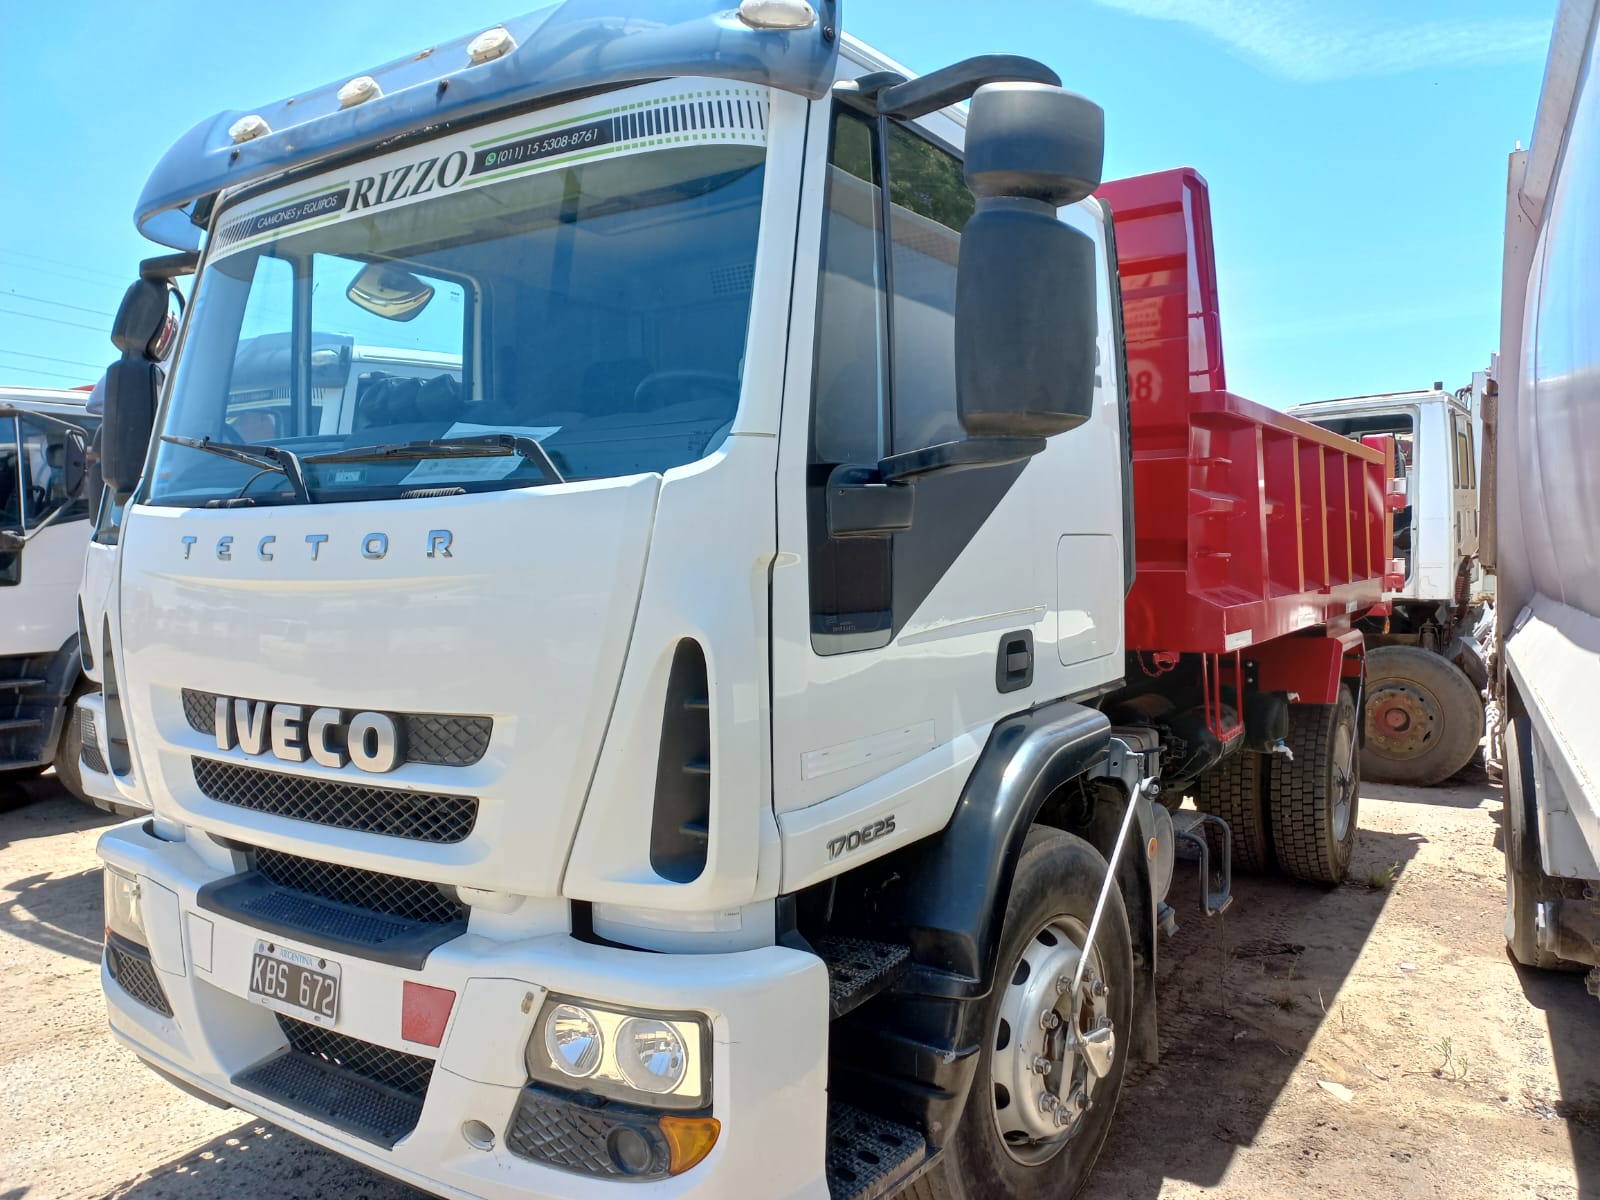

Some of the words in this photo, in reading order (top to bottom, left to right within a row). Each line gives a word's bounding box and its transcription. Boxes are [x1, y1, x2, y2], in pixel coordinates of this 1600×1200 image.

[497, 146, 524, 165] (011)
[527, 143, 540, 156] 15
[541, 128, 598, 152] 5308-8761
[347, 150, 468, 213] RIZZO
[257, 208, 296, 229] CAMIONES
[302, 195, 338, 214] EQUIPOS
[214, 696, 402, 774] IVECO
[826, 814, 896, 861] 170E25
[280, 948, 314, 967] ARGENTINA
[252, 956, 289, 999] KBS
[299, 971, 335, 1015] 672
